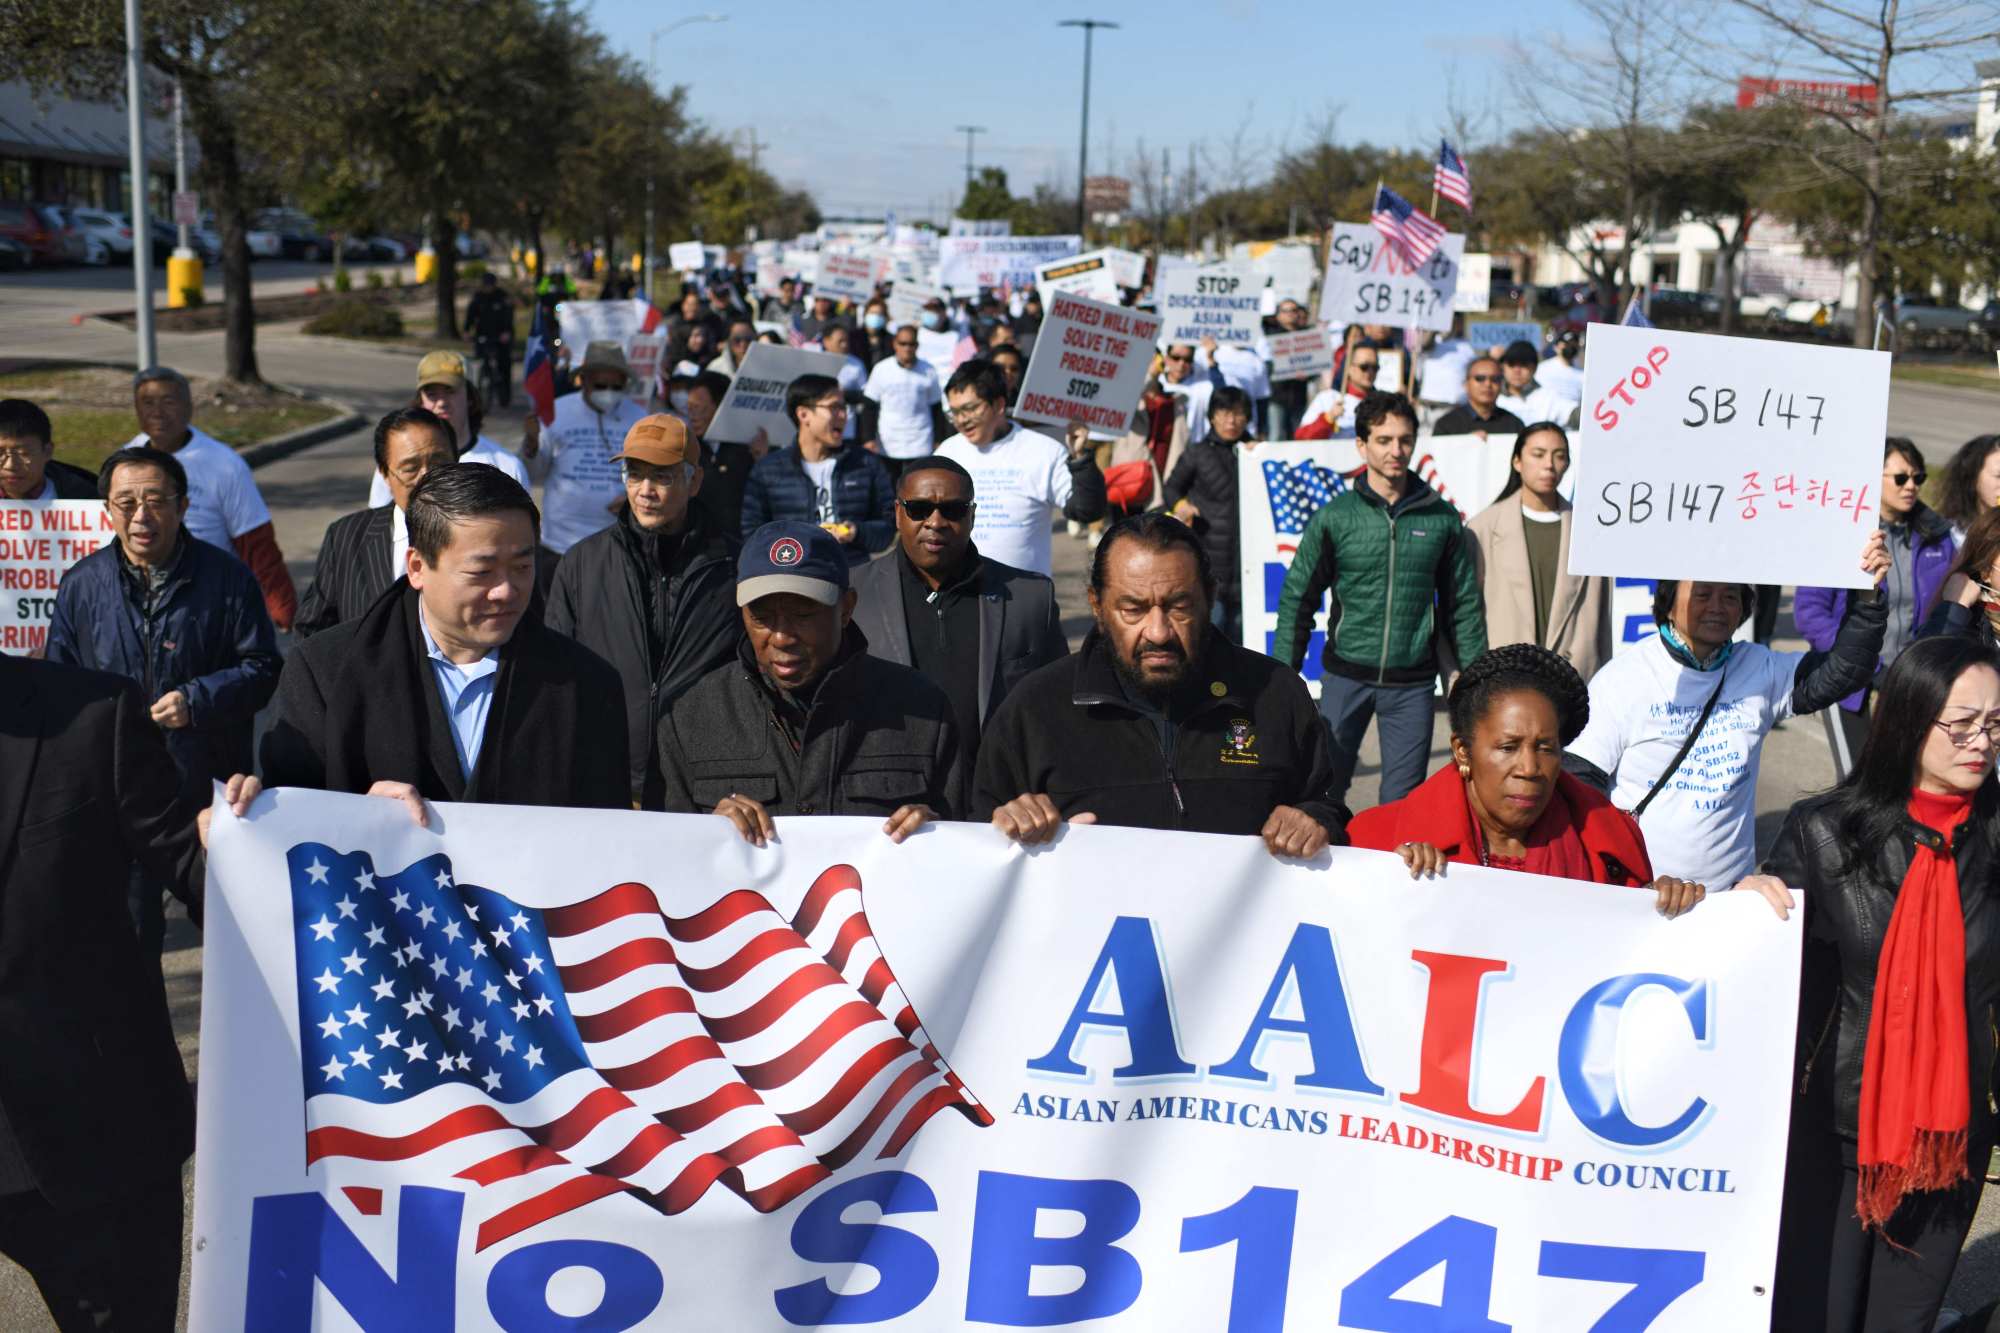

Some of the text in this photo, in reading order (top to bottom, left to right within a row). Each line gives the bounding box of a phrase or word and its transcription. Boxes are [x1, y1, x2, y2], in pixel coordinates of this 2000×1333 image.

[1332, 234, 1374, 273] Say
[1196, 276, 1240, 294] STOP
[1355, 283, 1392, 313] SB
[1168, 295, 1260, 311] DISCRIMINATE
[1193, 312, 1233, 325] ASIAN
[1052, 298, 1158, 340] HATRED WILL NOT
[1062, 327, 1130, 359] SOLVE THE
[1175, 327, 1251, 343] AMERICANS
[1060, 351, 1119, 380] PROBLEM
[1066, 377, 1101, 400] STOP
[1594, 346, 1670, 431] STOP
[1022, 393, 1128, 430] DISCRIMINATION
[1683, 386, 1826, 436] SB 147
[41, 510, 92, 531] WILL
[1027, 915, 1717, 1149] AALC
[1012, 1091, 1736, 1194] ASIAN AMERICANS LEADERSHIP COUNCIL
